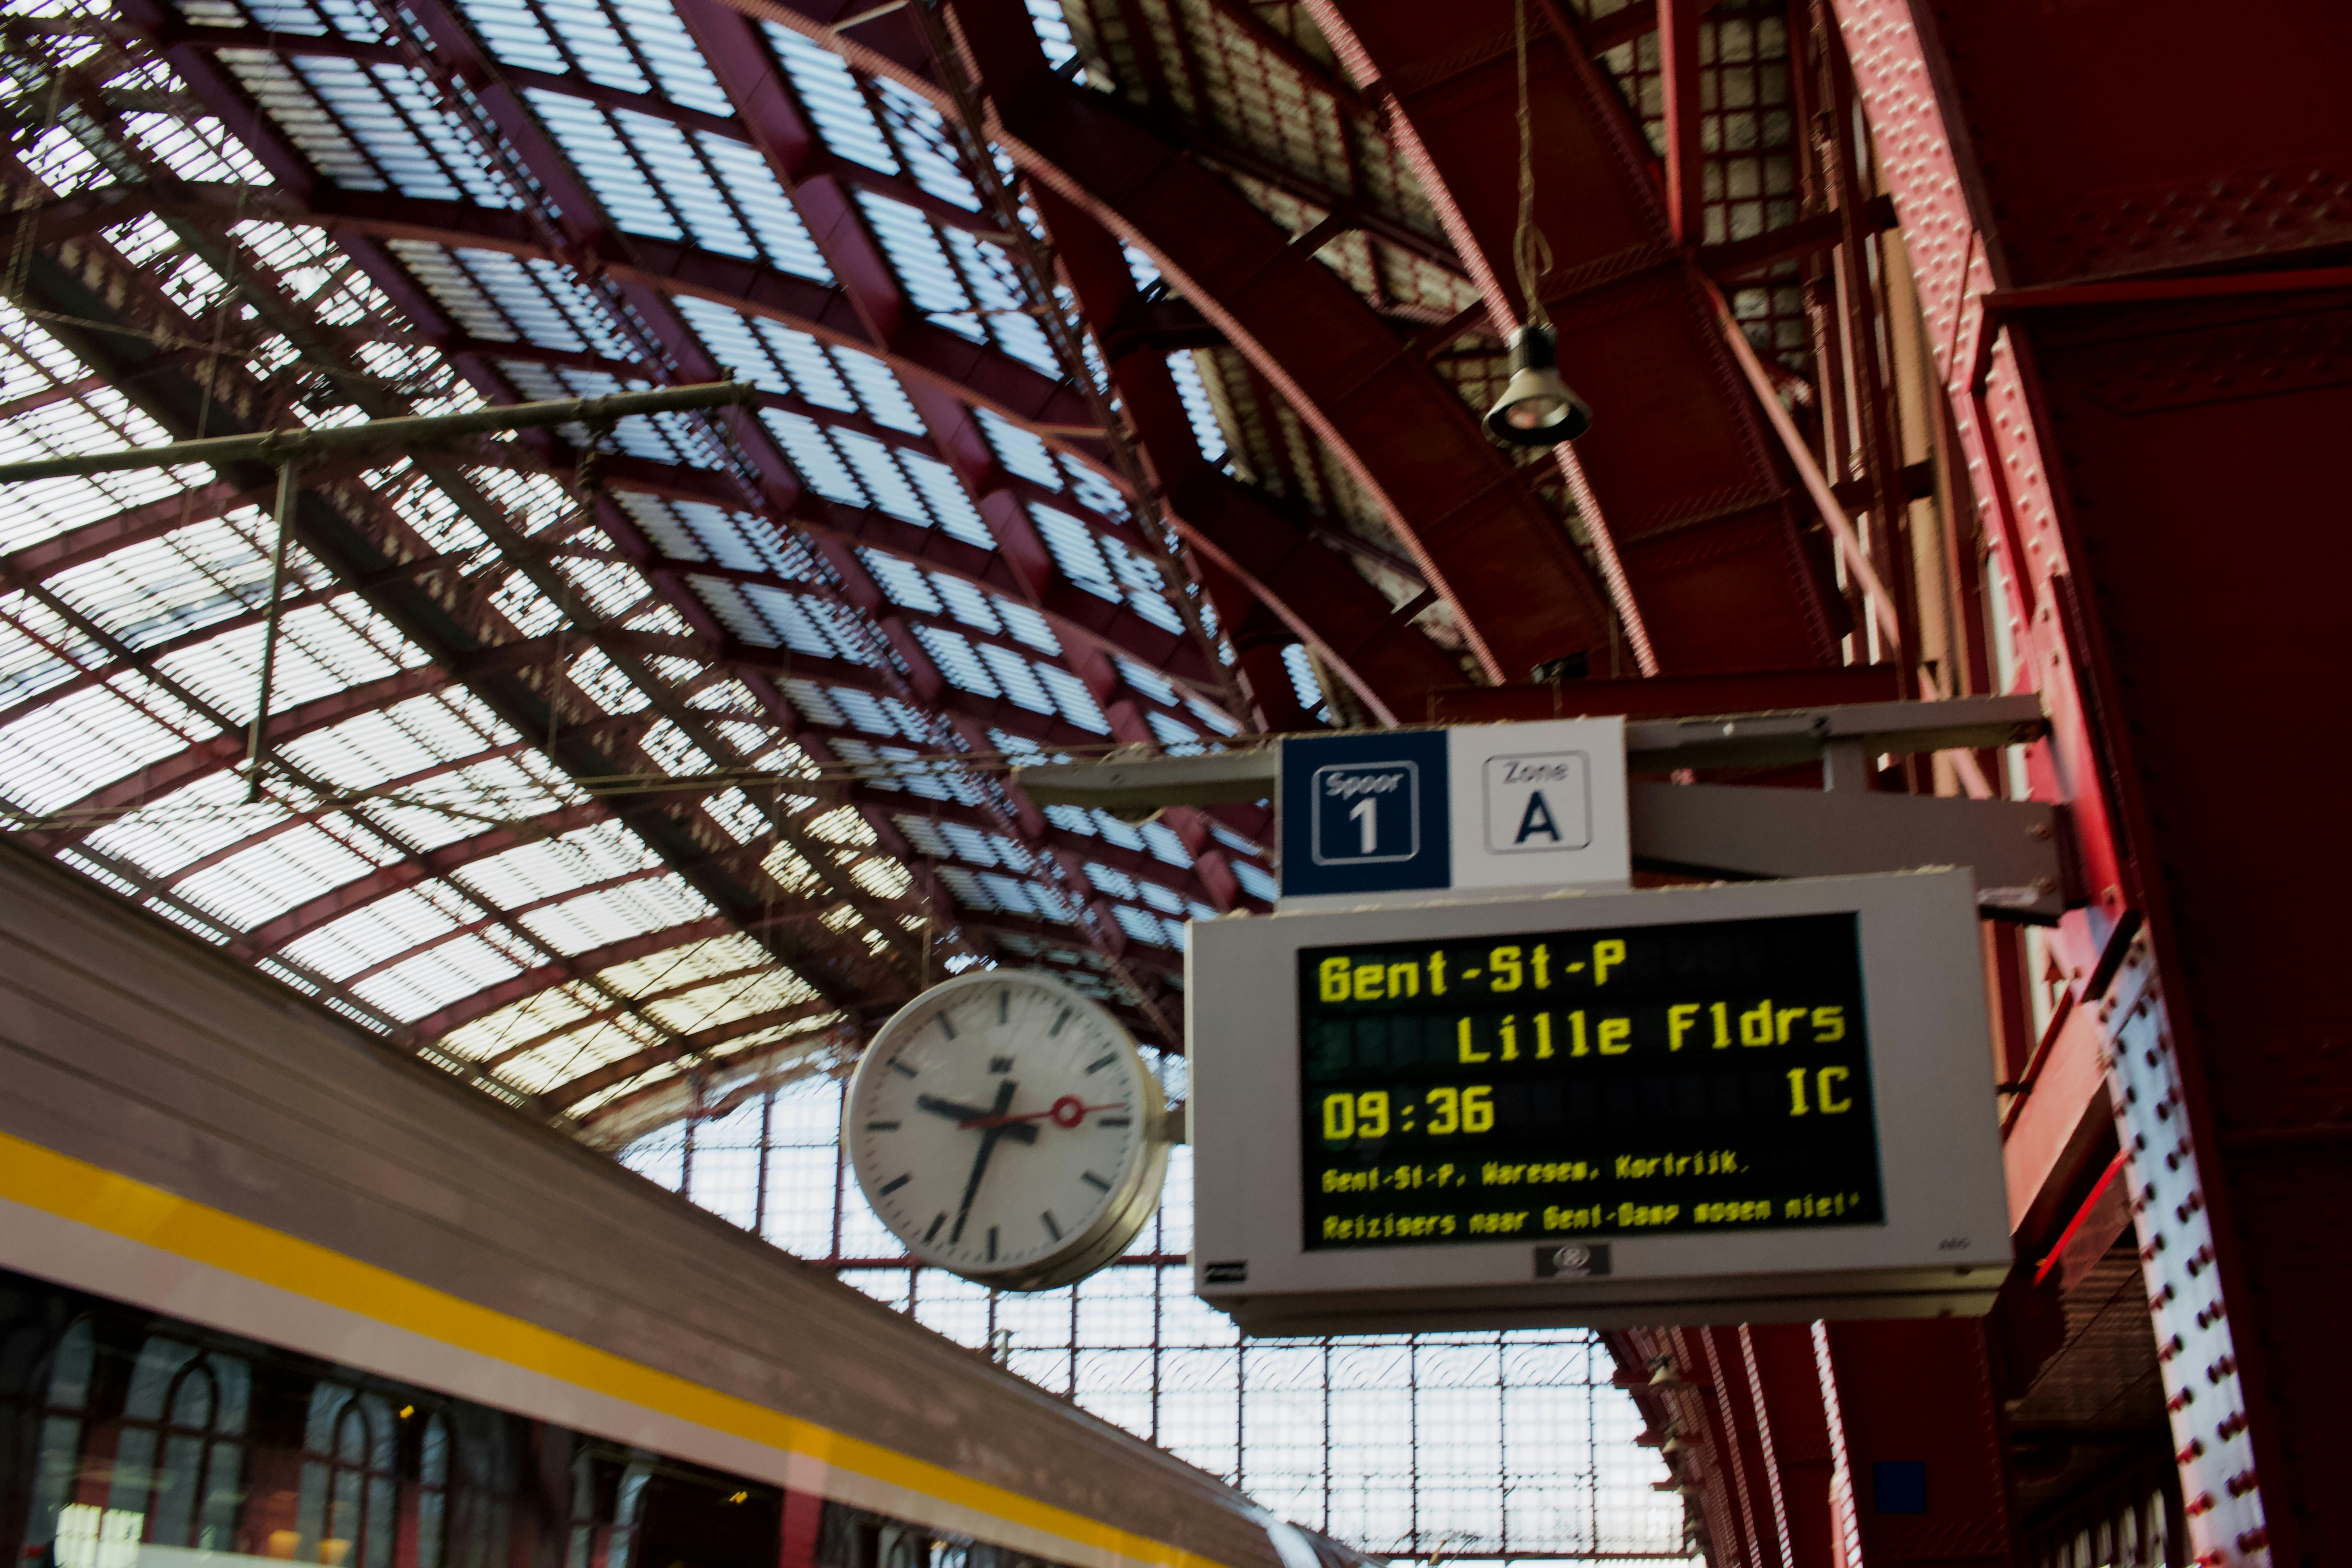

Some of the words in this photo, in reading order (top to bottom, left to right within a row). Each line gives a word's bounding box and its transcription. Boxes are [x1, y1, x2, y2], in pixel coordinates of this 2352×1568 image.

[1325, 772, 1404, 799] Spoor
[1501, 761, 1570, 785] Zone
[1349, 797, 1376, 854] 1
[1512, 790, 1564, 845] A
[1319, 939, 1626, 1002] Gent-St-P
[1458, 1010, 1631, 1063] Lille
[1667, 999, 1845, 1051] Fldrs
[1323, 1085, 1494, 1140] 09:36
[1787, 1066, 1851, 1116] IC
[1323, 1214, 1456, 1239] Reizigers
[1469, 1212, 1529, 1233] naar
